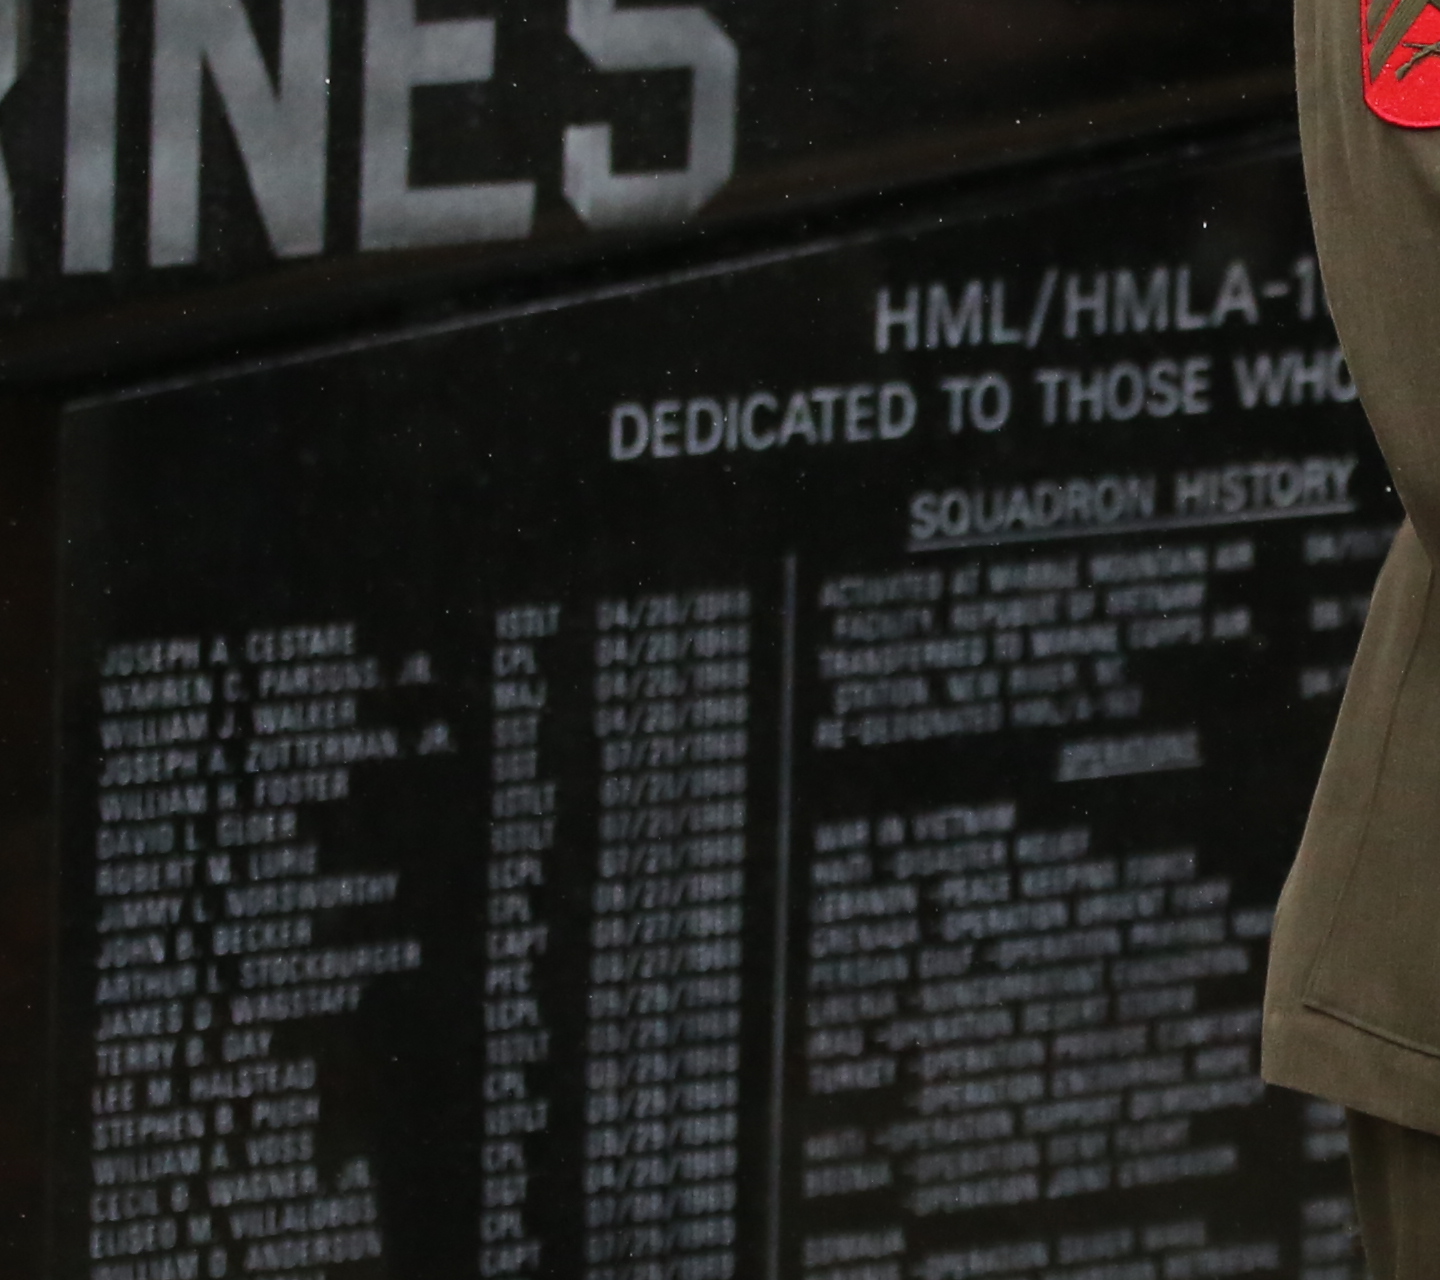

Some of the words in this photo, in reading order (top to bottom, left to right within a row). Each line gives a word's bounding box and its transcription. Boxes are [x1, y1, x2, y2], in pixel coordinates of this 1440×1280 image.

[874, 257, 1331, 353] HML/HMLA-1
[610, 381, 918, 461] DEDICATED
[940, 370, 1012, 433] TO
[1036, 357, 1212, 426] THOSE
[1234, 347, 1357, 410] WHO
[909, 475, 1157, 541] SQUADRON
[1176, 456, 1357, 514] HISTORY
